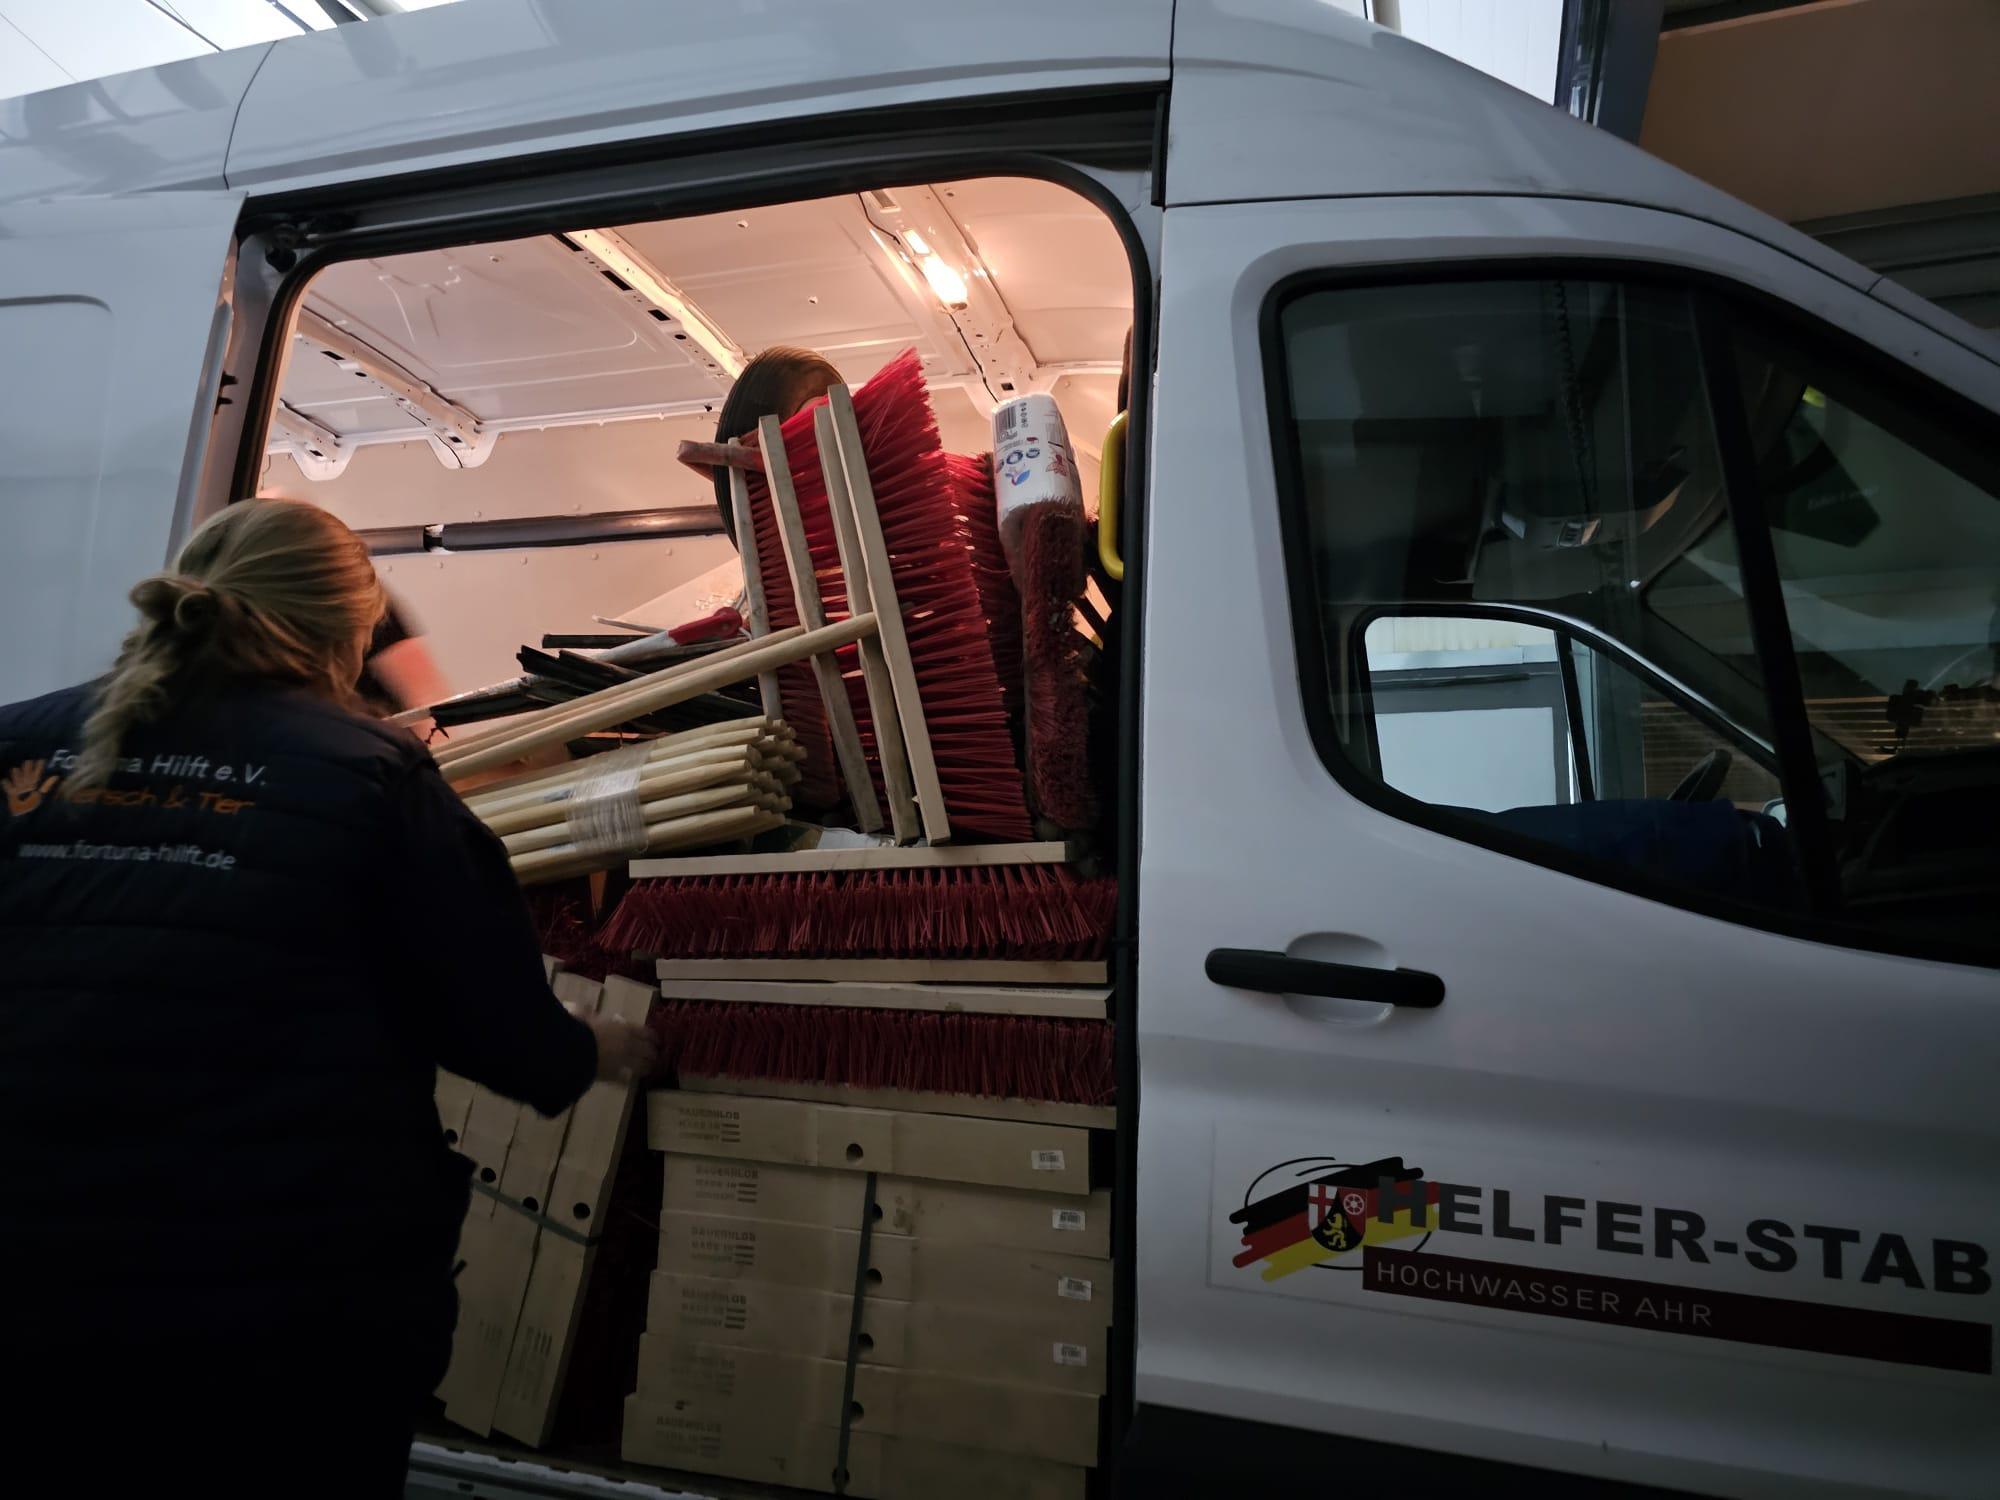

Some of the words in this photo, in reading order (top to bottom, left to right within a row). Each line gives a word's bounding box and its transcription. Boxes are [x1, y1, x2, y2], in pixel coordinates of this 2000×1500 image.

[149, 753, 211, 778] Hilft
[18, 840, 237, 870] www.fortuna-hilft.de
[1376, 1174, 1993, 1295] HELFER-STAB
[1376, 1260, 1621, 1315] HOCHWASSER
[1633, 1298, 1714, 1329] AHR
